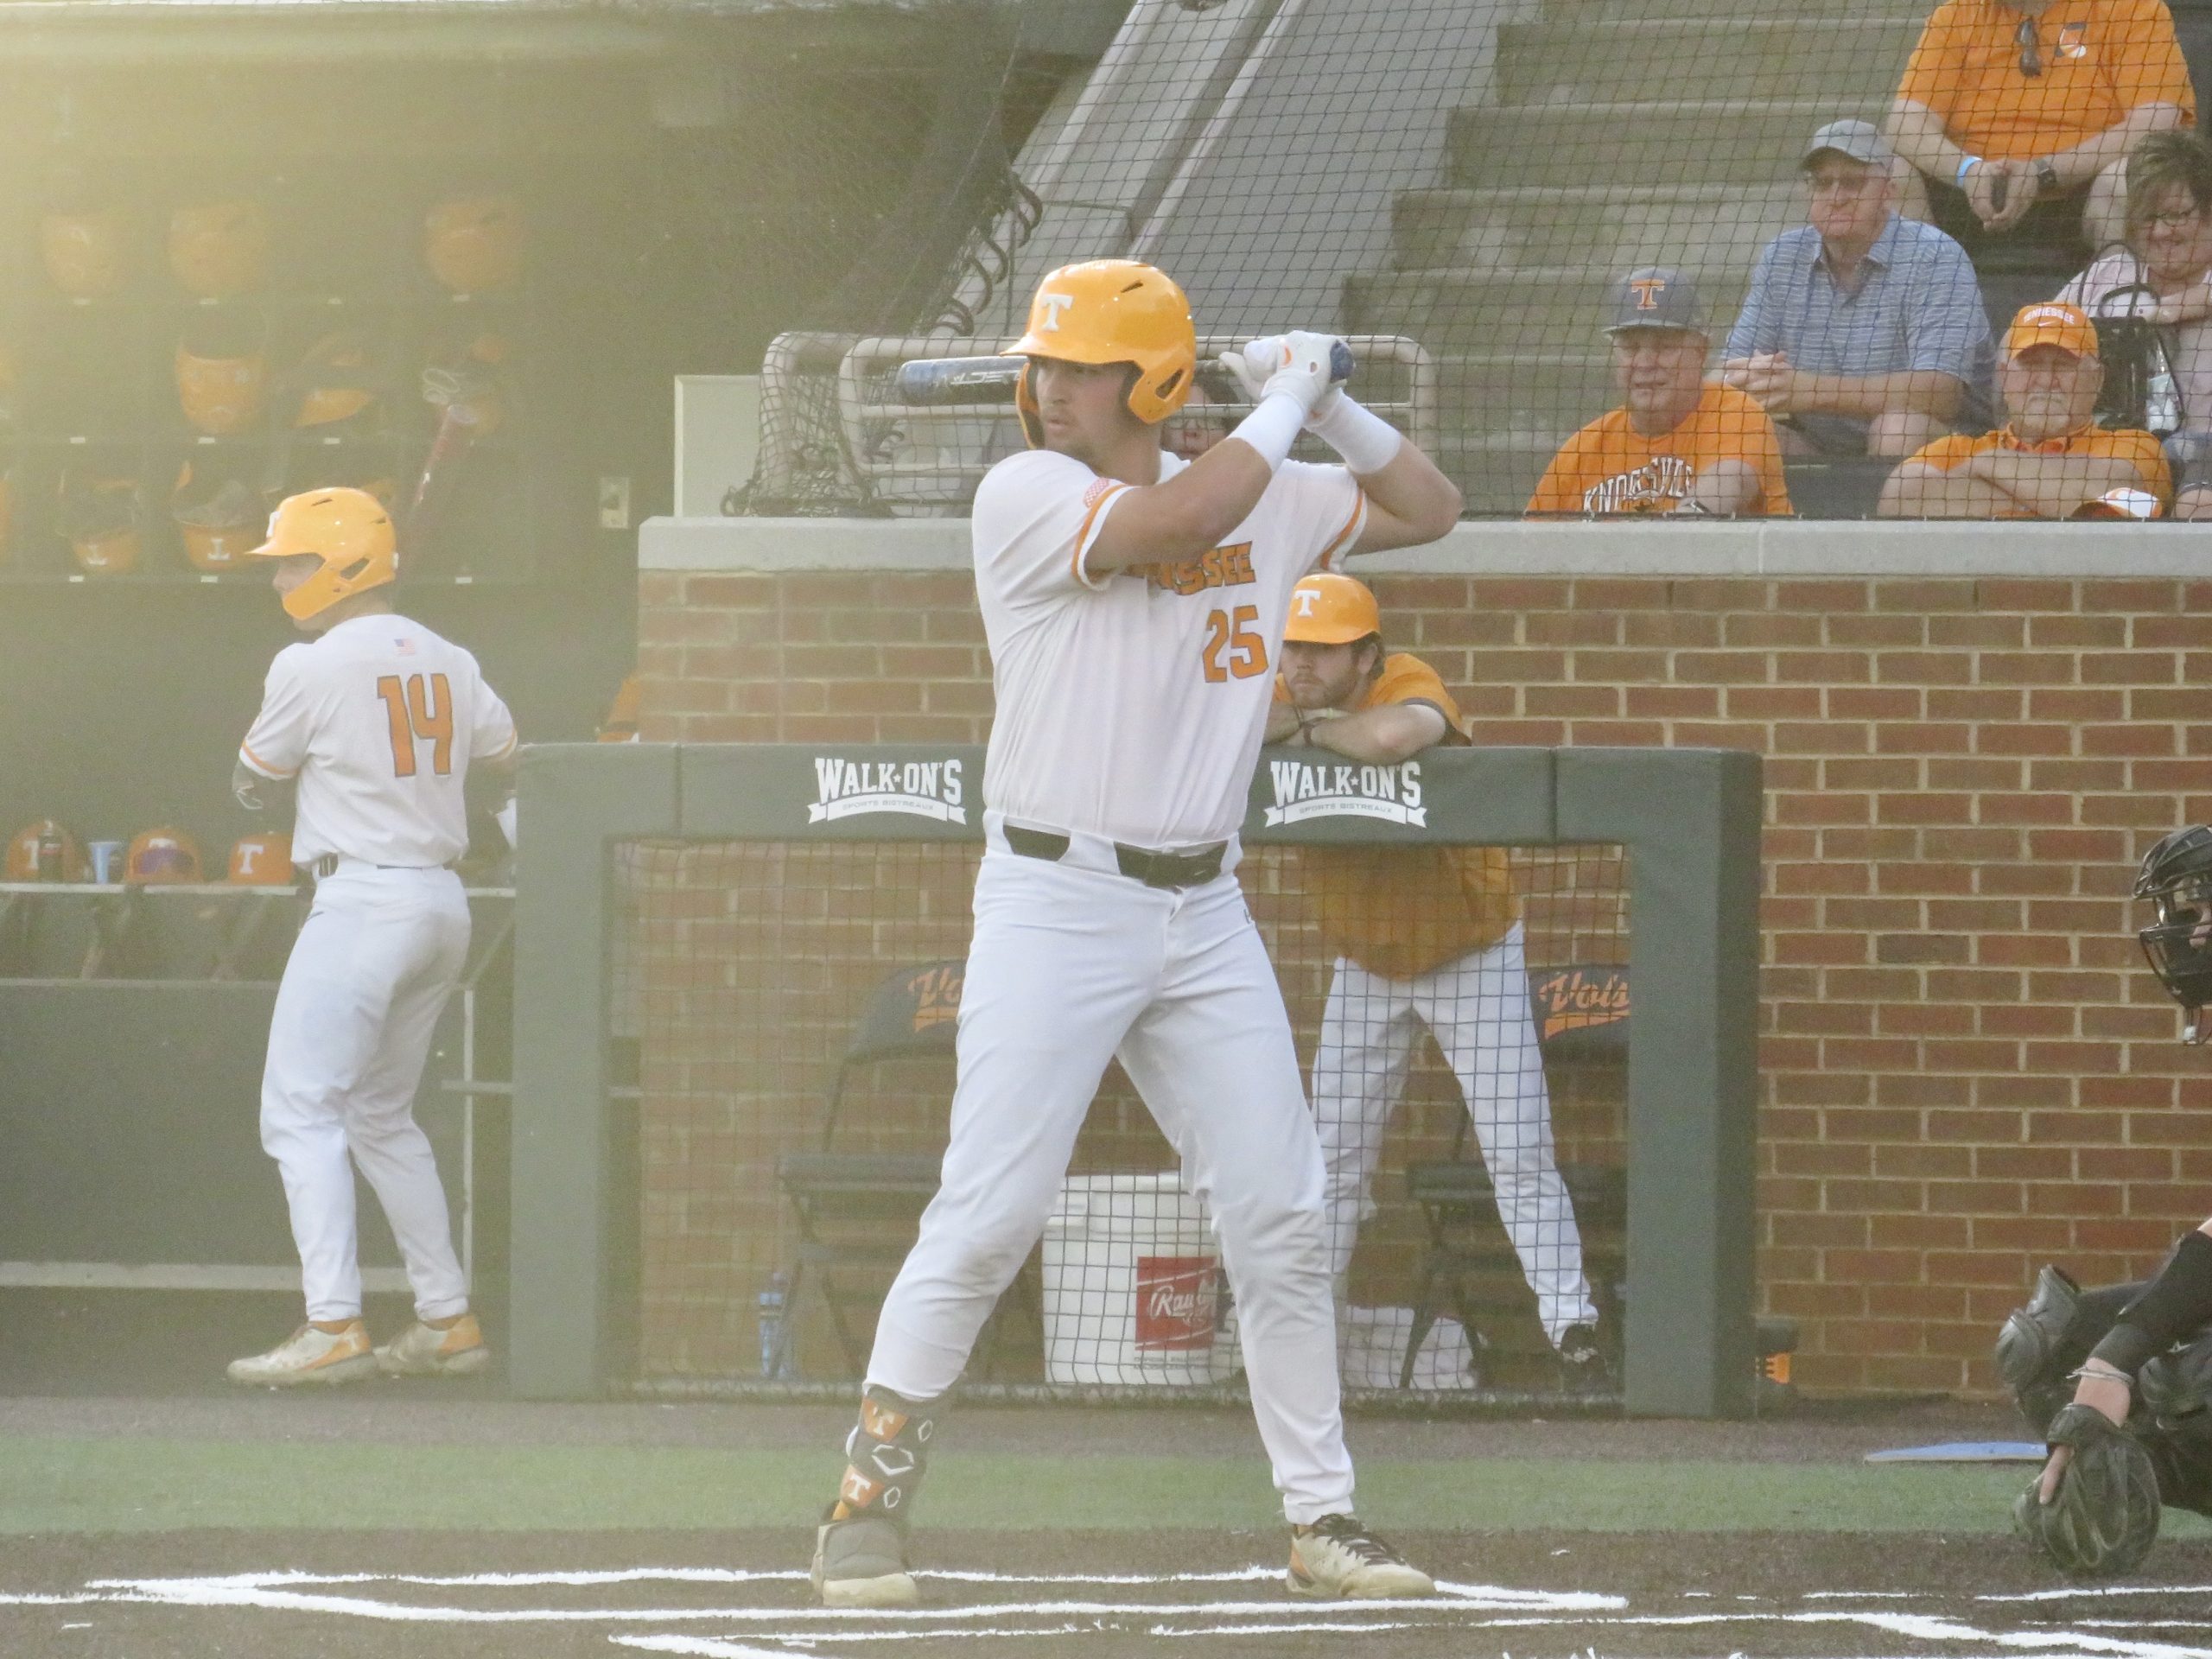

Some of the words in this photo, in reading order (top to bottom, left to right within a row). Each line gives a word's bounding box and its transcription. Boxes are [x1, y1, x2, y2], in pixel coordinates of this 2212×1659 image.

[1630, 277, 1665, 310] T
[1039, 294, 1074, 332] T
[1294, 589, 1321, 617] T
[1202, 605, 1268, 683] 25
[377, 672, 453, 778] 14
[238, 843, 264, 874] T
[1539, 970, 1631, 1014] Vols
[849, 1473, 872, 1502] T
